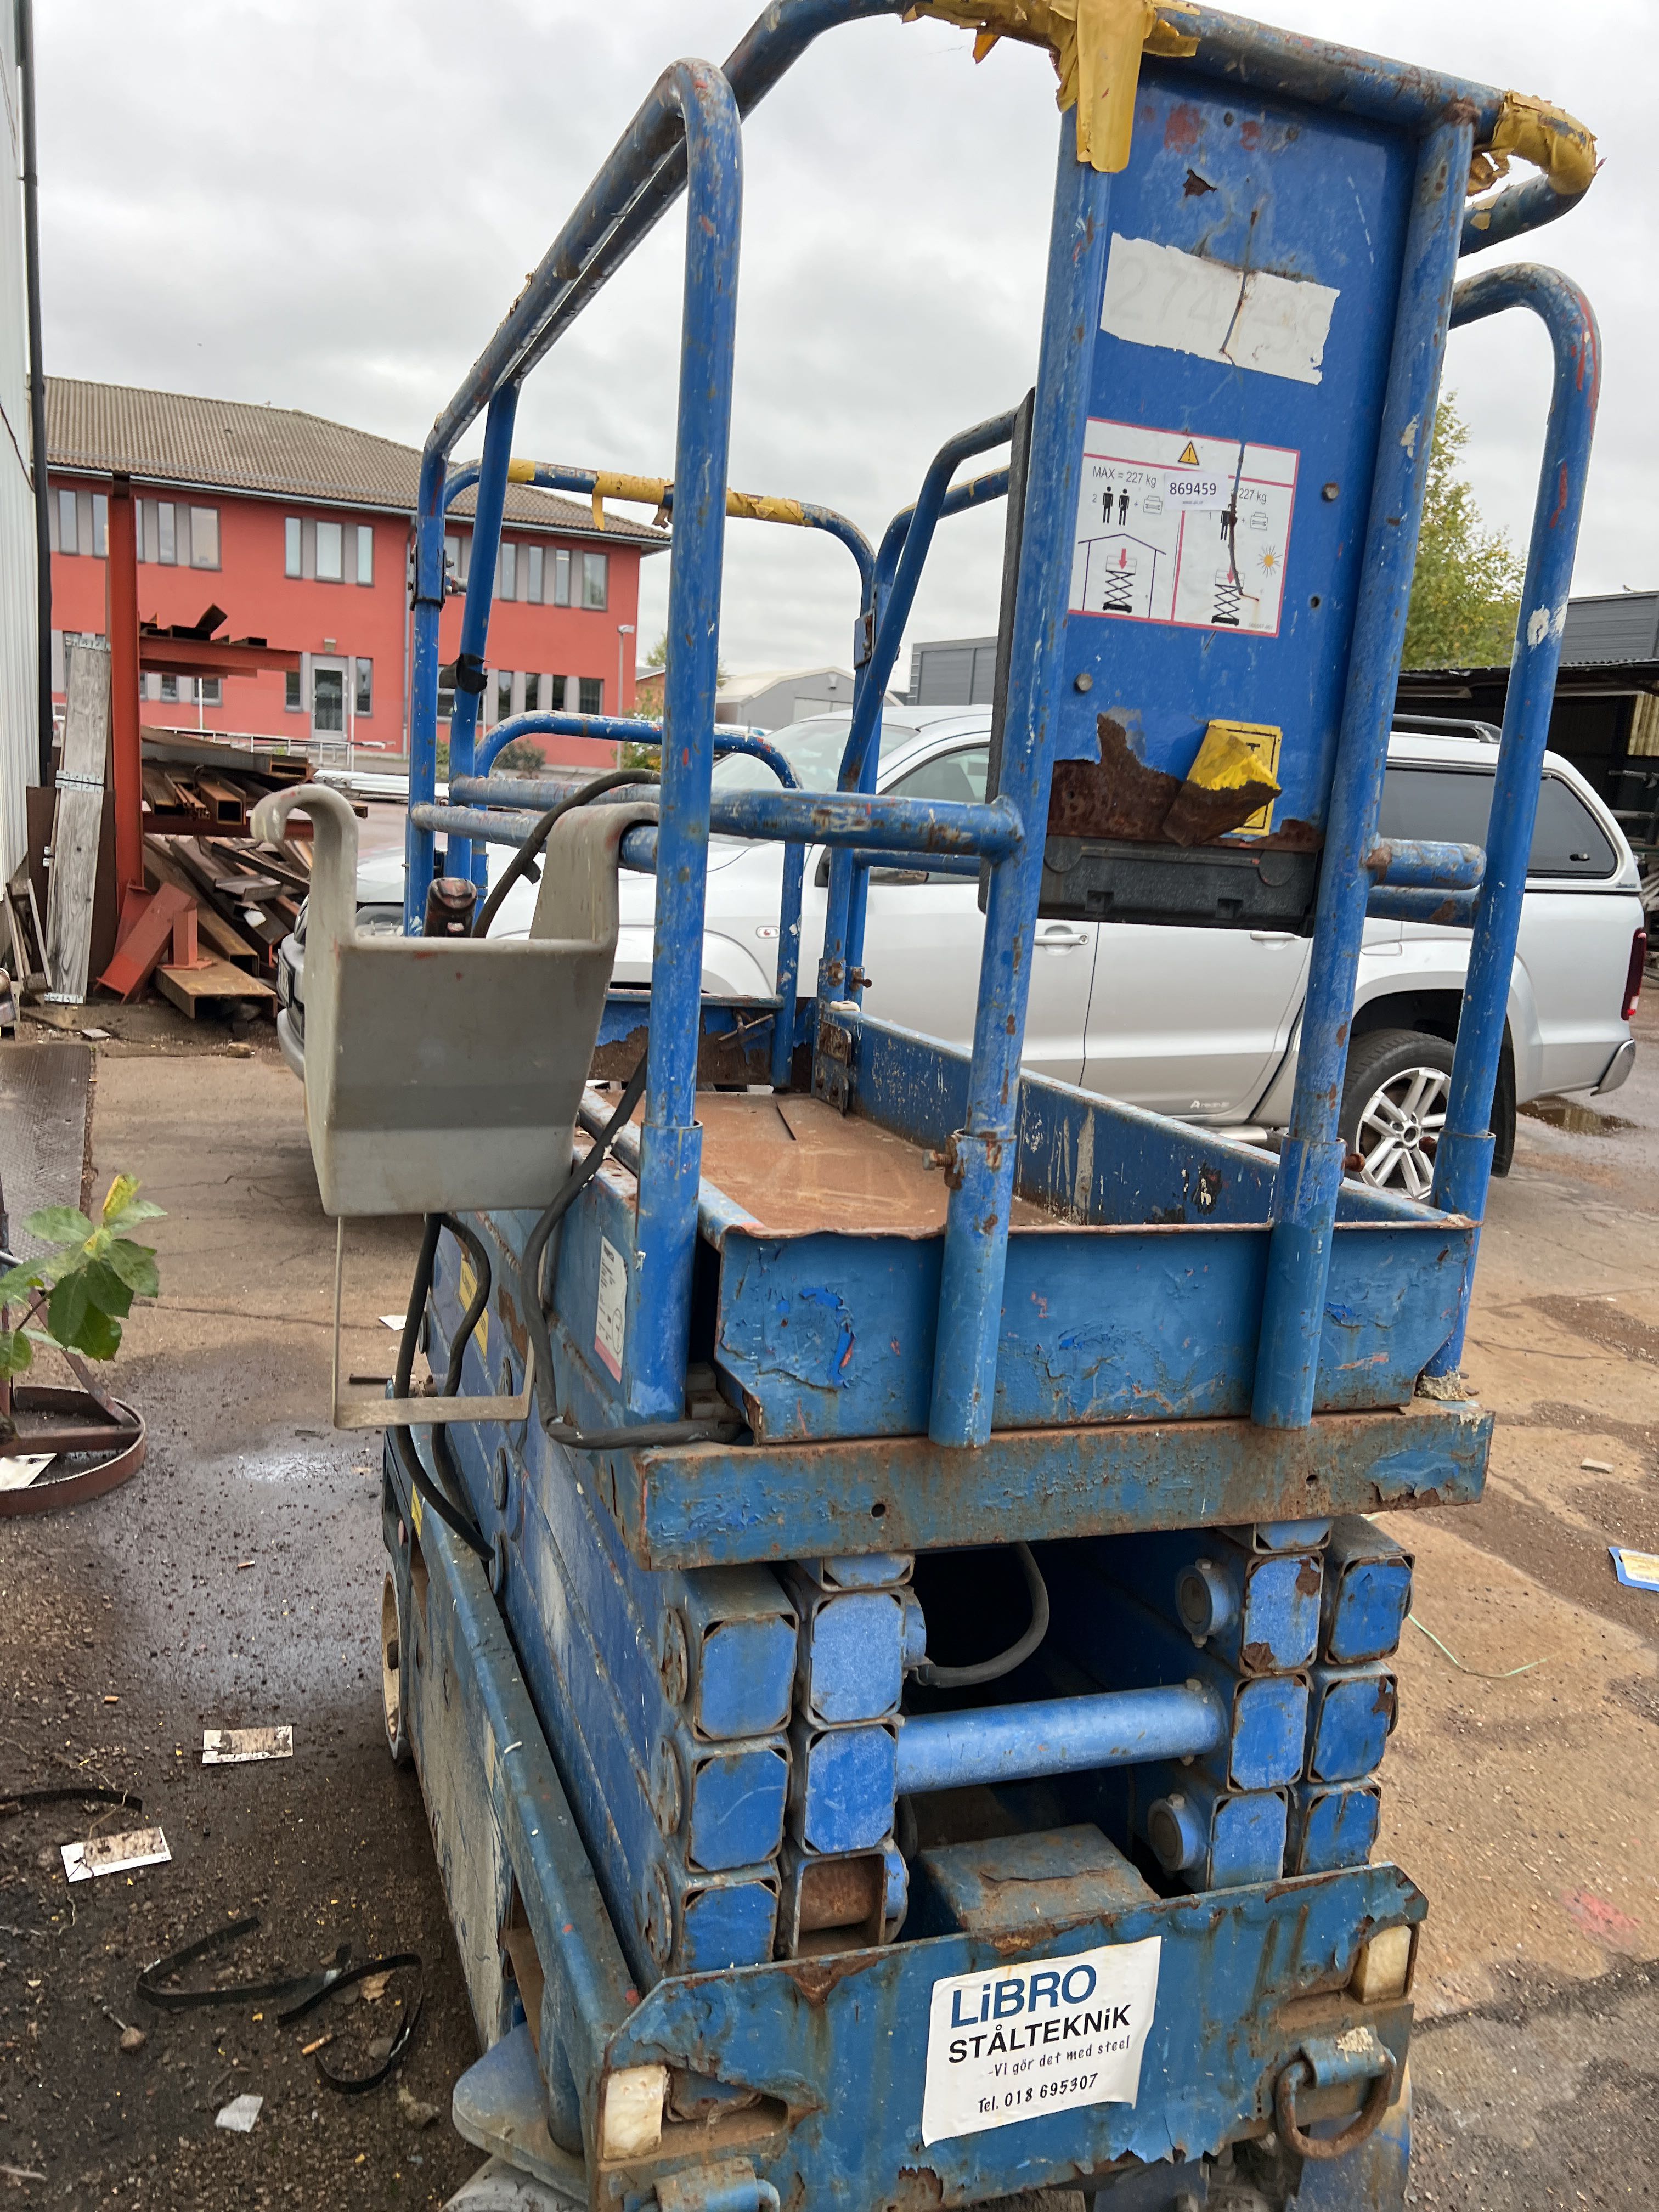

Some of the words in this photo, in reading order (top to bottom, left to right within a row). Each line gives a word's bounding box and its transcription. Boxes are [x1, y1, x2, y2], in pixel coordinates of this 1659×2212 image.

[1092, 465, 1115, 479] MAX
[1126, 471, 1144, 484] 227
[1146, 473, 1157, 489] kg
[1169, 482, 1217, 495] 869459
[1092, 493, 1097, 503] 2
[1238, 488, 1255, 500] 227
[1256, 490, 1267, 505] kg
[950, 1964, 1097, 2029] LiBRO
[948, 2004, 1132, 2064] STÅLTEKNiK
[1012, 2058, 1035, 2076] gör
[1039, 2051, 1062, 2067] det
[1066, 2044, 1093, 2061] med
[1097, 2035, 1131, 2055] steel
[978, 2095, 999, 2114] Tel.
[1004, 2087, 1033, 2107] 018
[1039, 2072, 1098, 2099] 695307
